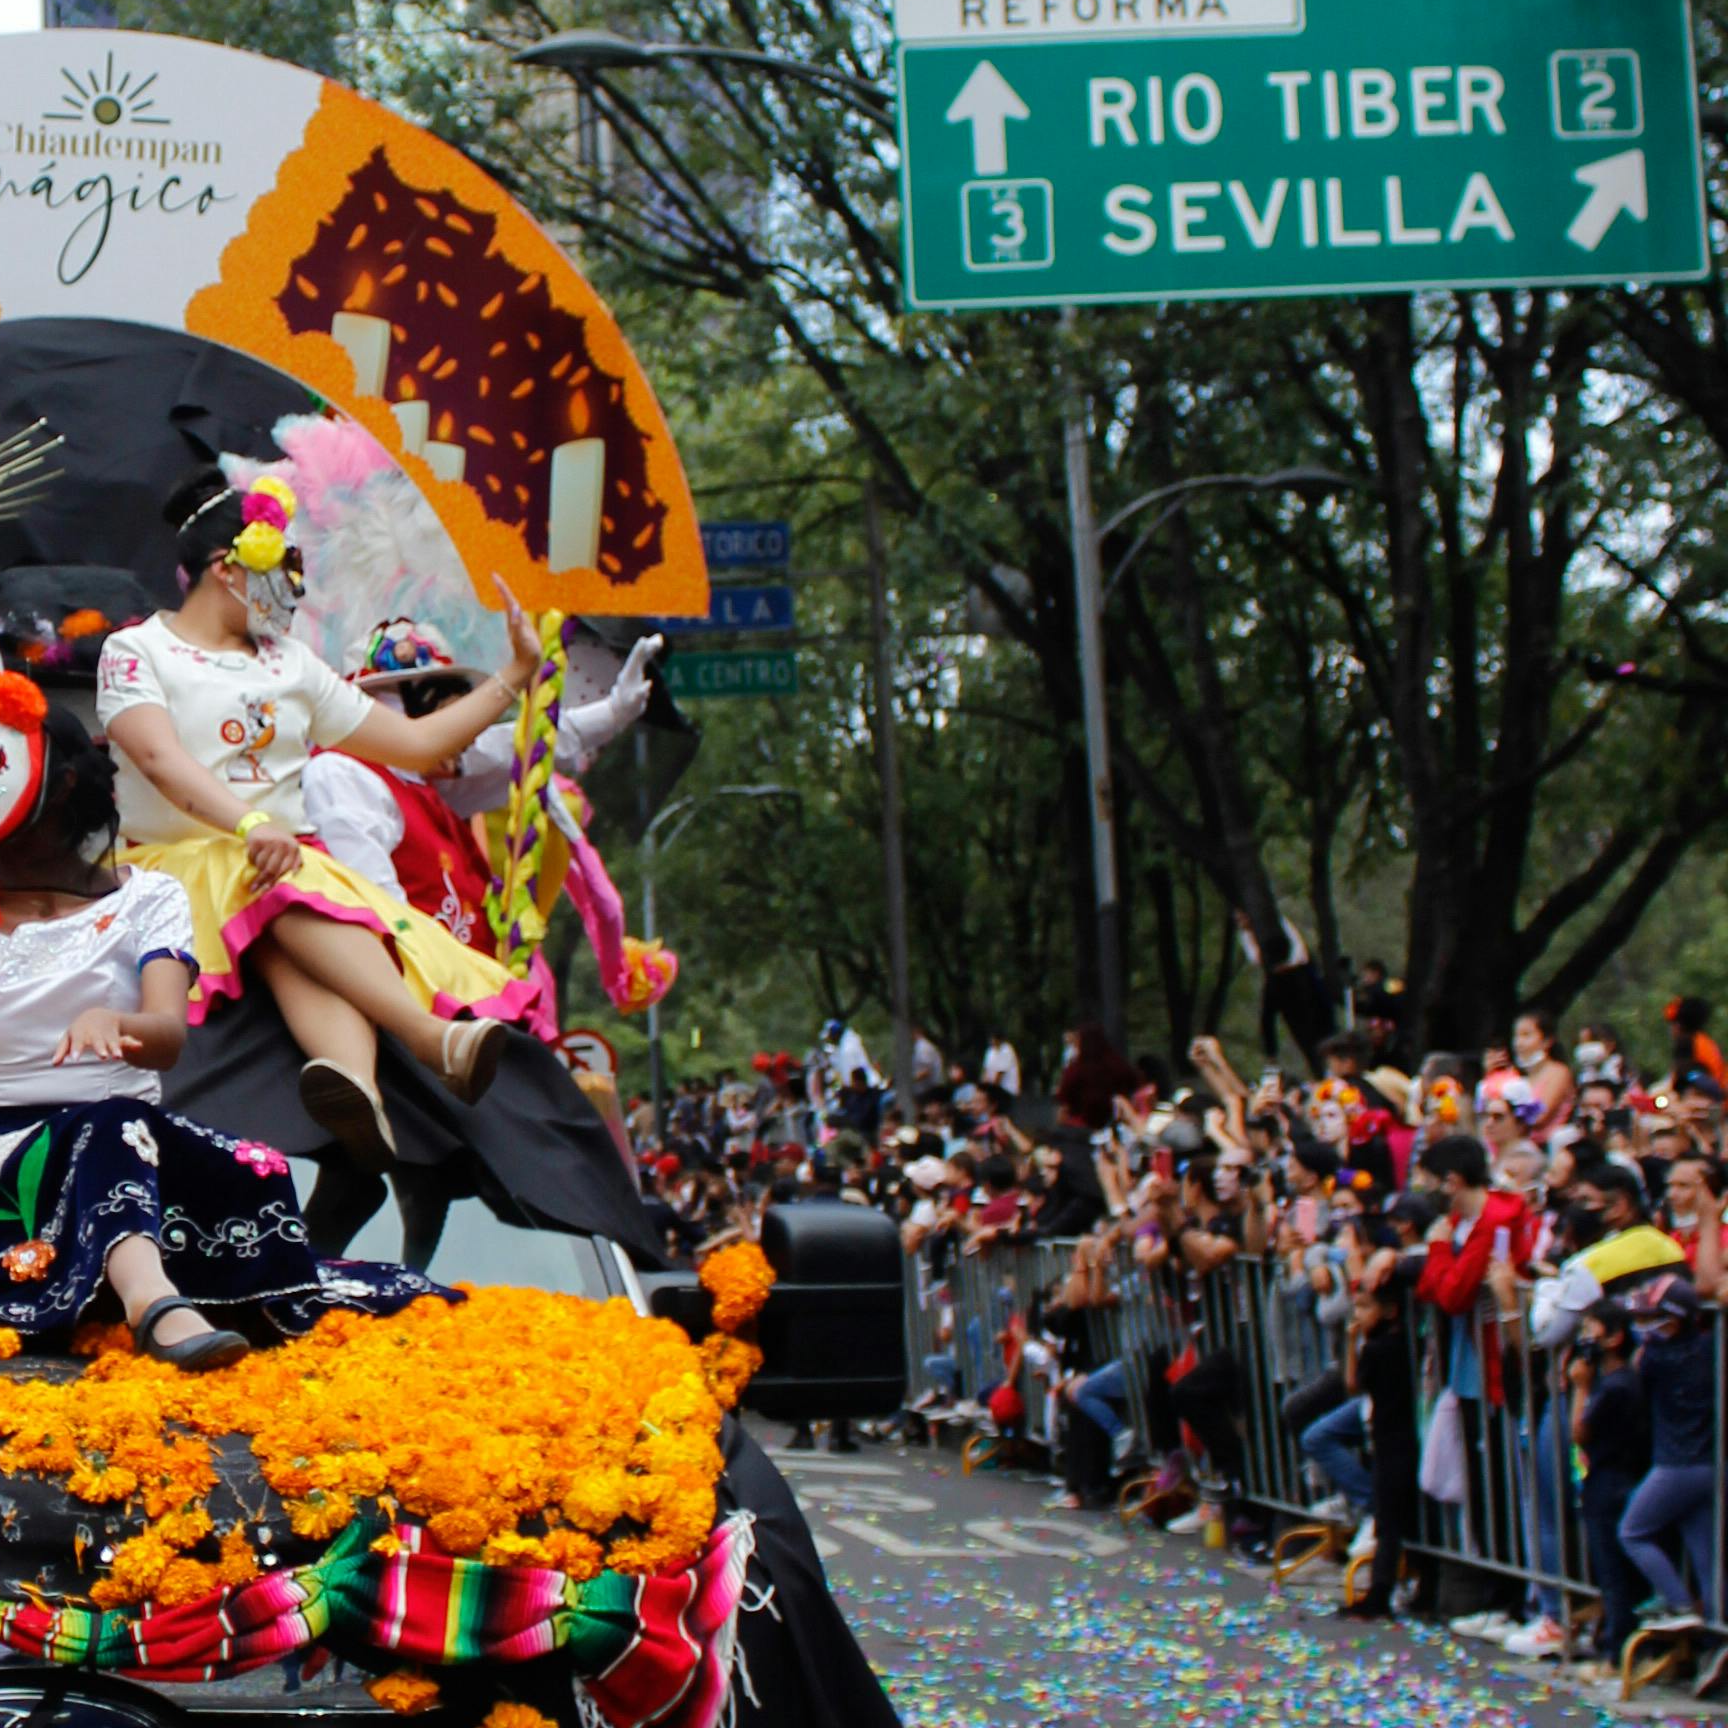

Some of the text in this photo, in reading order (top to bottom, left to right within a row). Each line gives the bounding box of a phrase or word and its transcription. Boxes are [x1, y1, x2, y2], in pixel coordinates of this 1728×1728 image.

[1087, 65, 1506, 148] RIO TIBER
[1580, 72, 1617, 121] 2
[992, 200, 1028, 247] 3
[1101, 172, 1515, 255] SEVILLA
